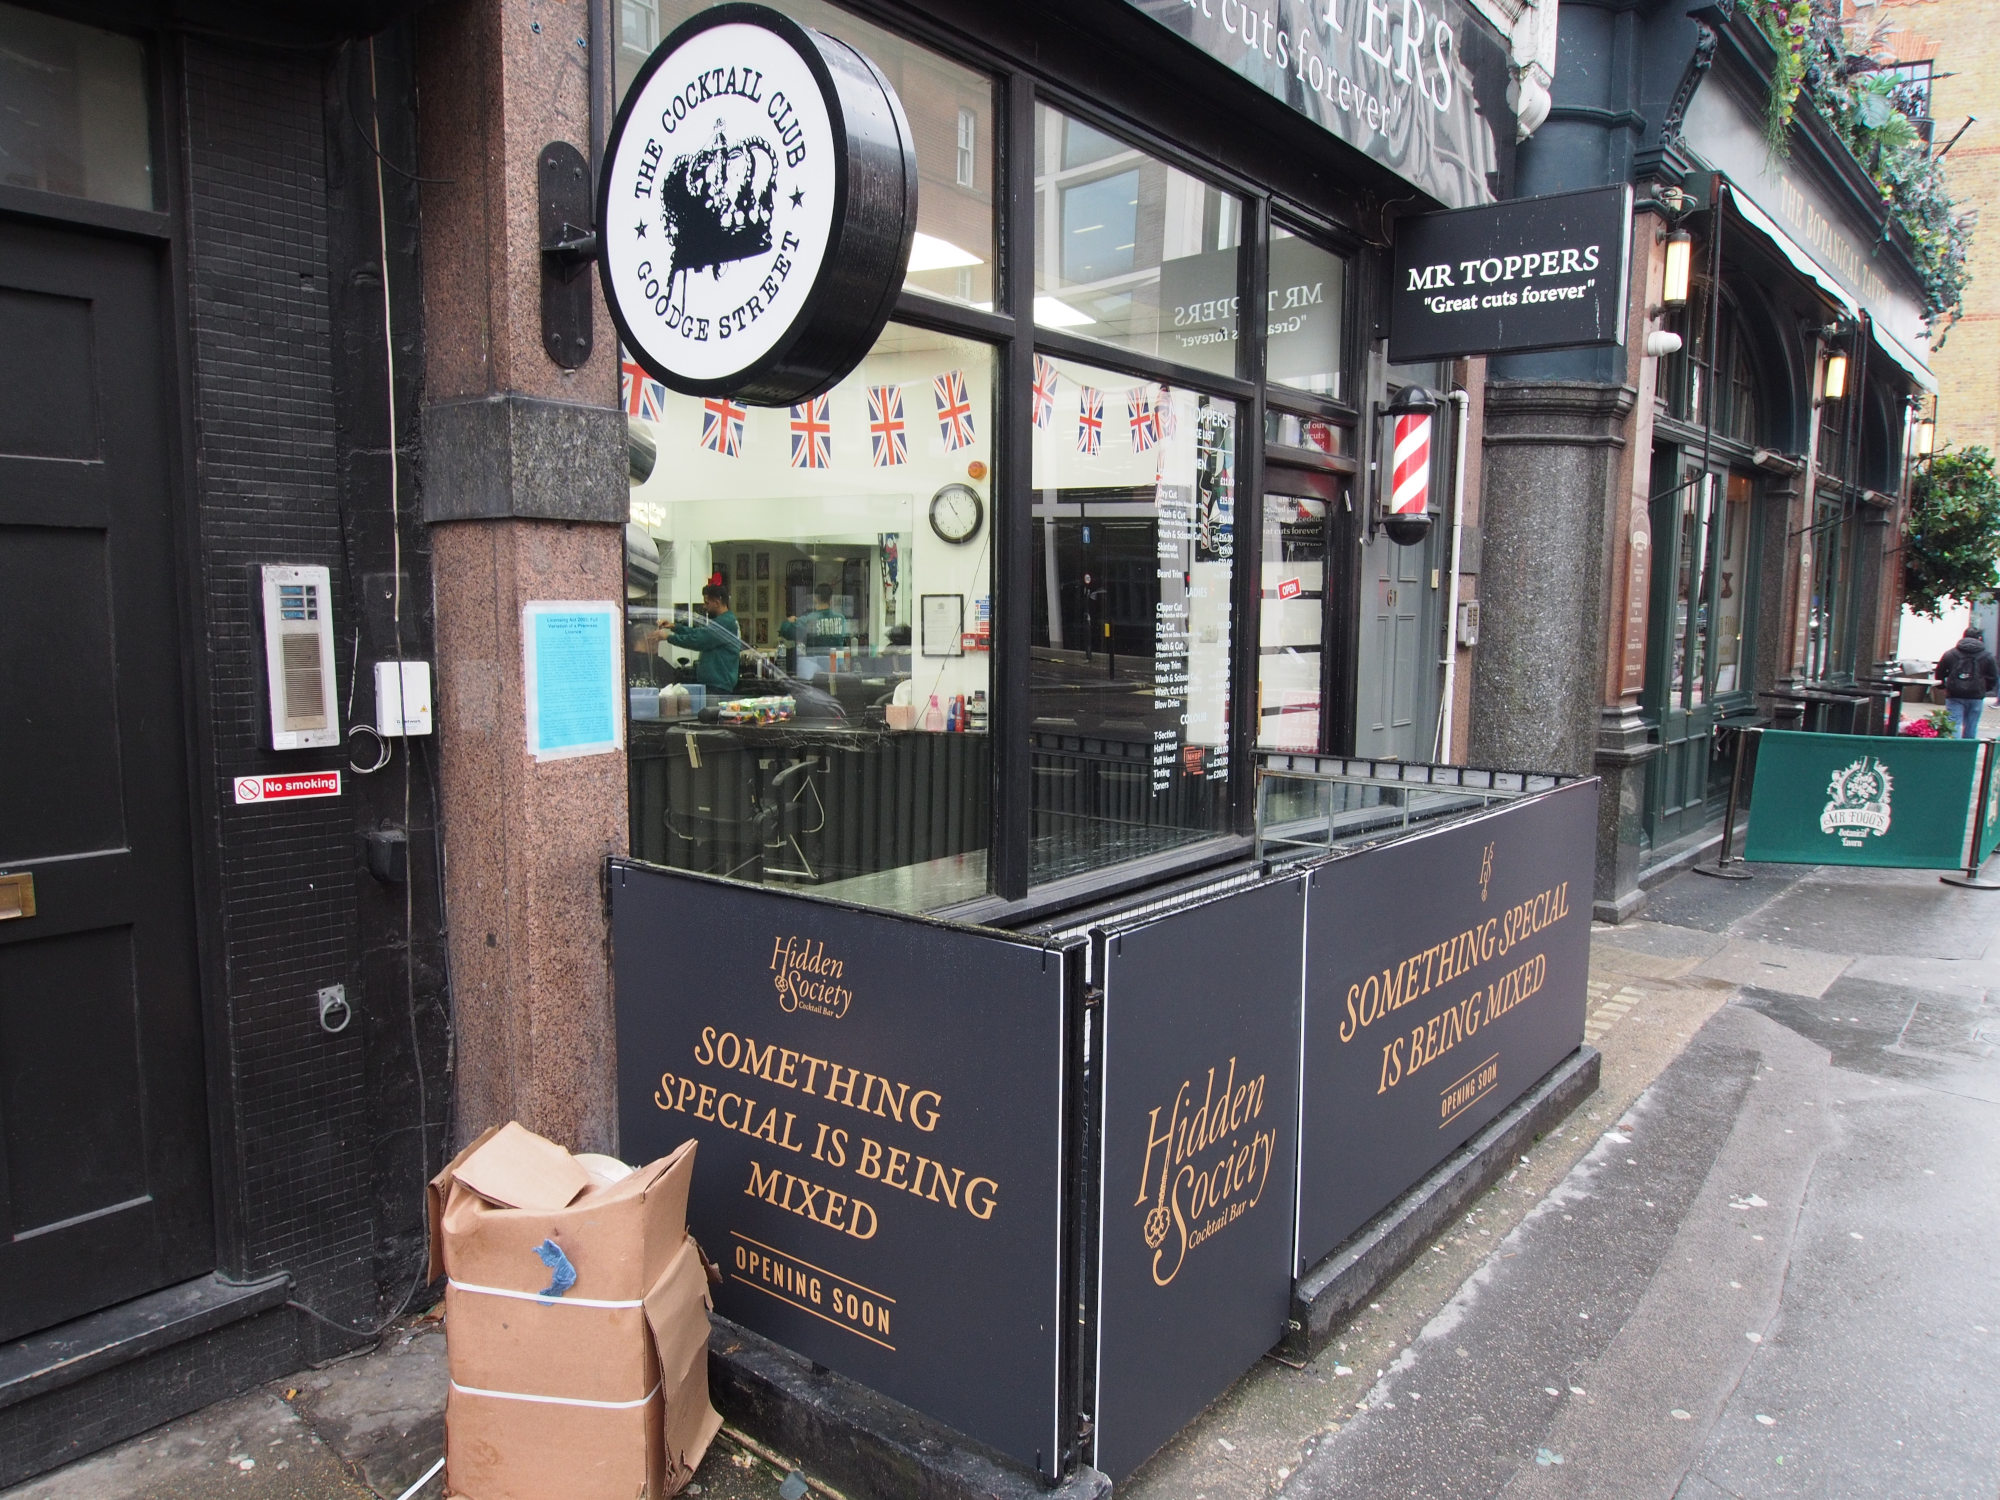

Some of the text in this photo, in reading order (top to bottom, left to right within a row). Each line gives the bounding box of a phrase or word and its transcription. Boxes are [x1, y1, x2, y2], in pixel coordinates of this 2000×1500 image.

[1221, 0, 1401, 138] cuts forever"
[634, 66, 806, 200] THE COCKTAIL CLUB
[1780, 175, 1804, 230] THE
[1806, 204, 1860, 286] BOTANICAL
[637, 230, 800, 342] GOODGE STREET
[1406, 245, 1599, 292] MR TOPPERS
[1424, 279, 1595, 314] "Great cuts forever"
[1195, 407, 1229, 428] OPPERS
[1197, 459, 1206, 470] EN
[1282, 583, 1297, 596] OPEN
[1154, 730, 1176, 740] T-Section
[1154, 741, 1177, 753] Half Head
[265, 777, 336, 792] No smoking
[1153, 756, 1163, 766] Full
[1163, 754, 1176, 764] Head
[1153, 782, 1169, 791] Toners
[769, 936, 843, 980] Hidden
[1339, 881, 1569, 1043] SOMETHING SPECIAL
[779, 970, 852, 1018] Society
[799, 1001, 834, 1016] Cocktail Bar
[1377, 953, 1546, 1095] IS BEING MIXED
[694, 1026, 942, 1132] SOMETHING
[1441, 1062, 1497, 1118] OPENING SOON
[654, 1072, 998, 1220] SPECIAL IS BEING
[1134, 1056, 1265, 1207] Hidden
[744, 1161, 878, 1240] MIXED
[1152, 1128, 1276, 1286] Society
[1188, 1200, 1246, 1249] Cocktail Bar
[736, 1246, 890, 1334] OPENING SOON
